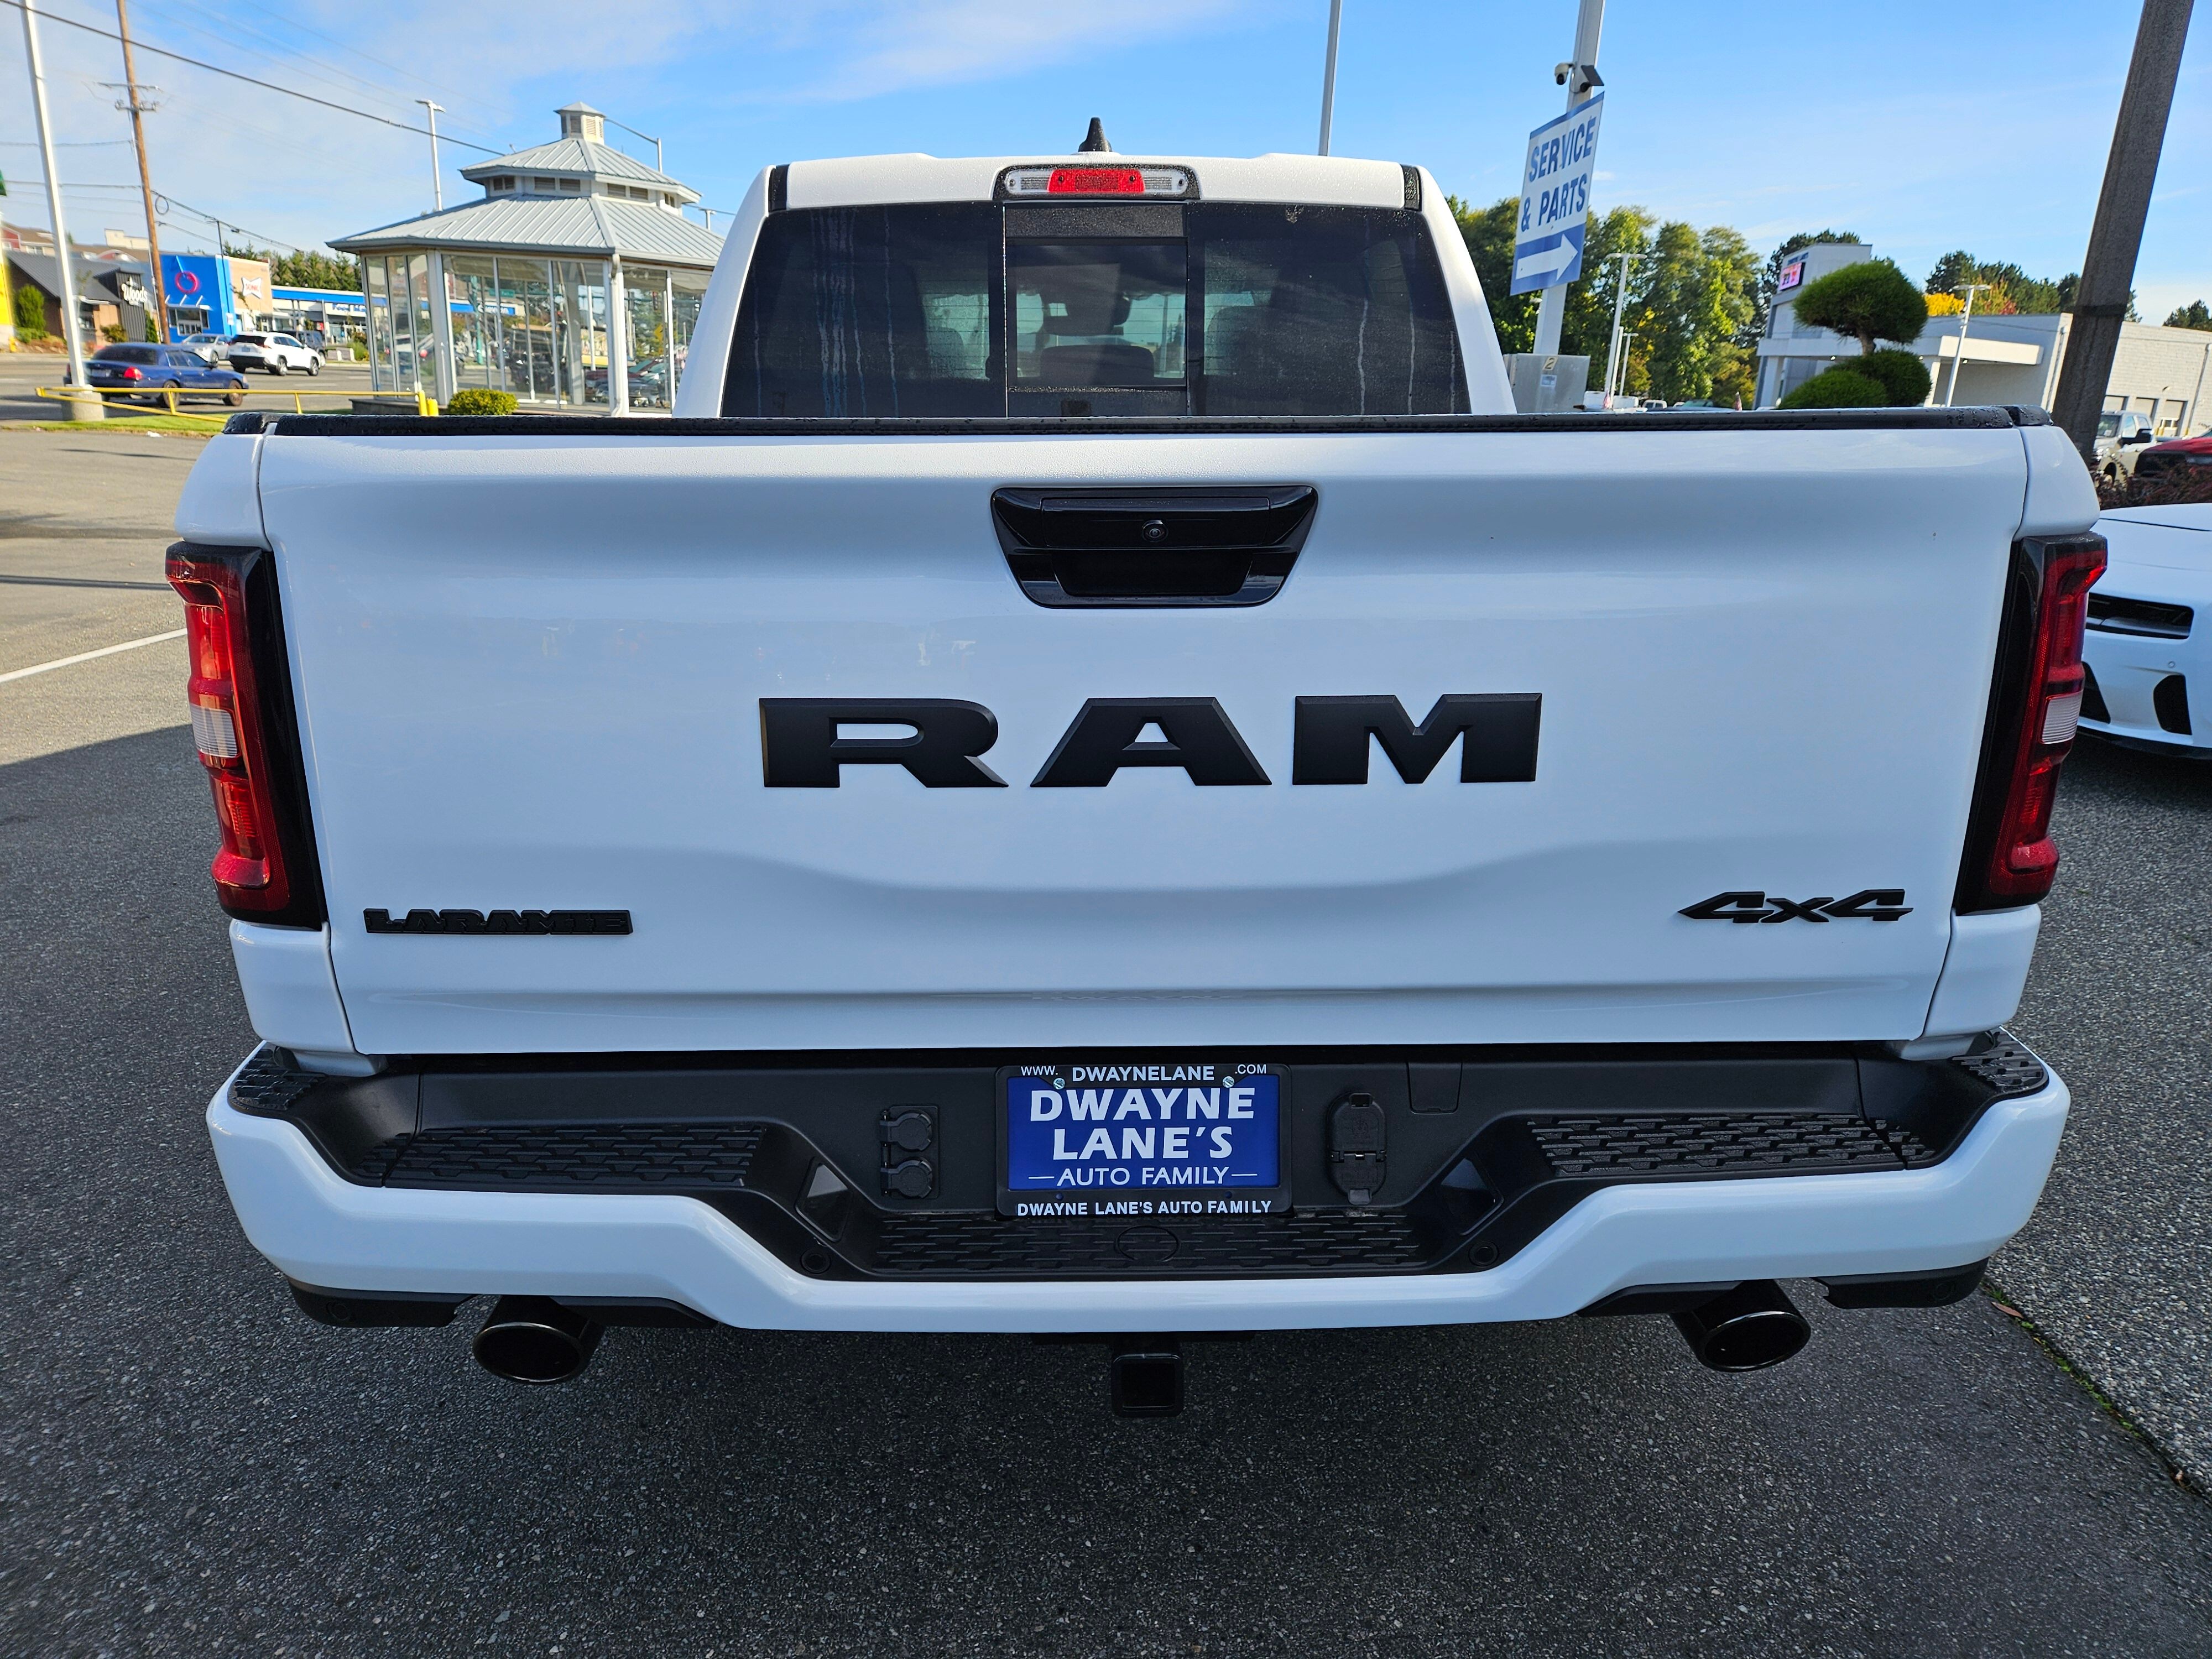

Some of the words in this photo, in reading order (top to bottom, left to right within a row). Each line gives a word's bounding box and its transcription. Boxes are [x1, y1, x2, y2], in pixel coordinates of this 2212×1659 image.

[1529, 116, 1597, 182] SERVICE
[1521, 196, 1531, 232] &
[1538, 173, 1588, 226] PARTS
[121, 283, 148, 303] Woods
[1545, 357, 1554, 369] 2
[759, 692, 1542, 789] RAM
[363, 908, 633, 935] LARAMIE
[1677, 889, 1914, 924] 4x4
[1072, 1066, 1214, 1082] DWAYNELANE
[1030, 1087, 1256, 1121] DWAYNE
[1053, 1126, 1233, 1161] LANE'S
[1056, 1167, 1130, 1186] AUTO
[1142, 1166, 1230, 1185] FAMILY
[1018, 1202, 1088, 1216] DWAYNE
[1095, 1201, 1153, 1215] LANE'S
[1157, 1201, 1203, 1214] AUTO
[1208, 1200, 1271, 1213] FAMILY
